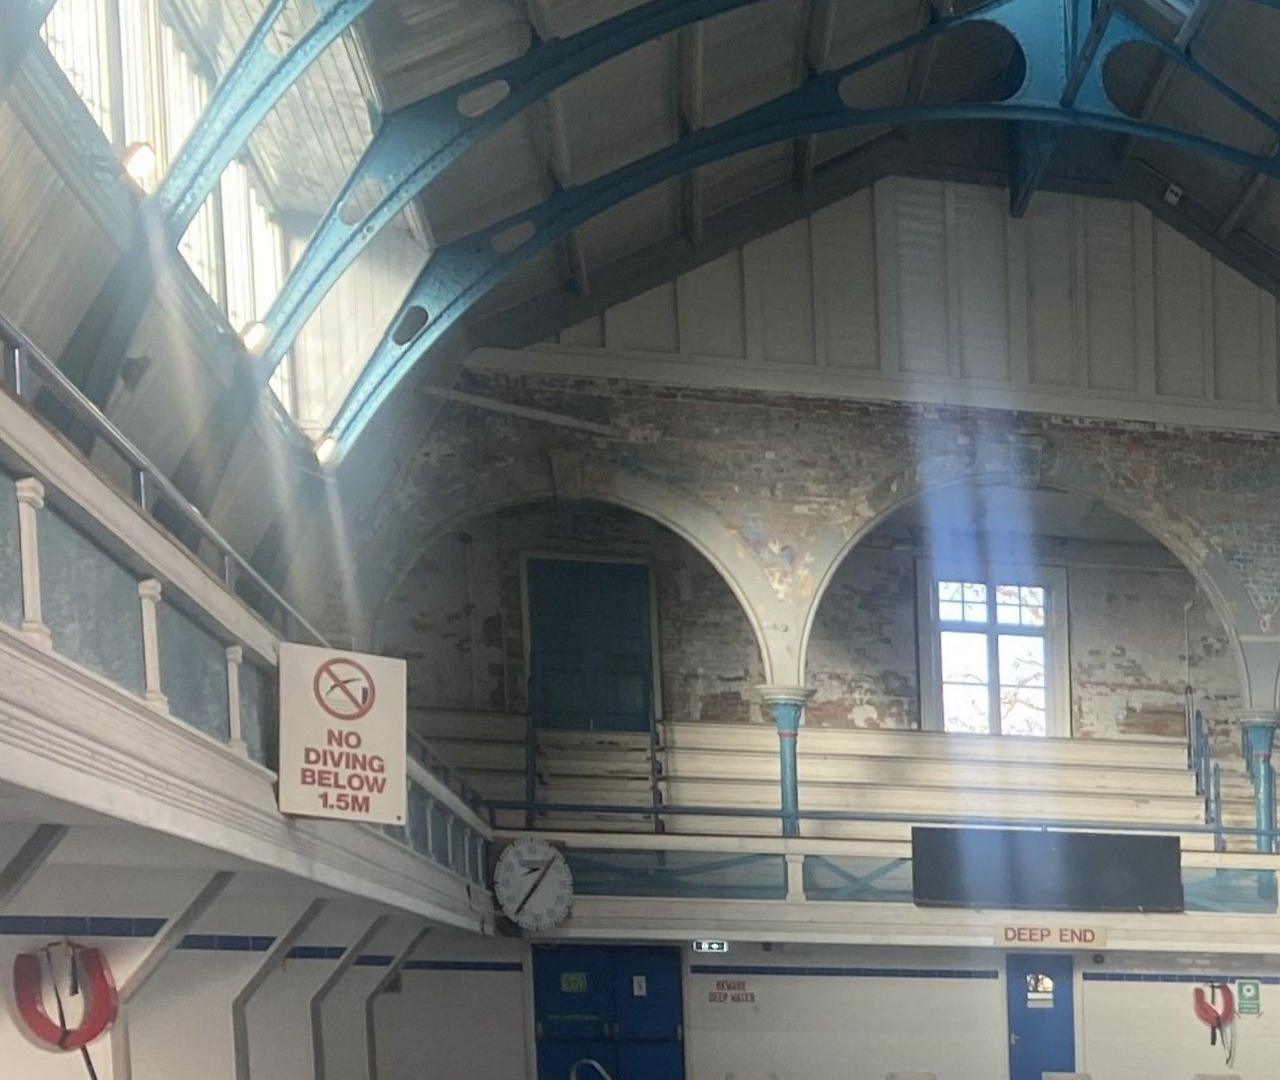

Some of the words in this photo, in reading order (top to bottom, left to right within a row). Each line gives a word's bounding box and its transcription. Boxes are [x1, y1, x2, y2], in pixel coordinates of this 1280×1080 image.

[327, 729, 362, 749] NO
[304, 747, 385, 773] DIVING
[300, 768, 387, 794] BELOW
[318, 792, 370, 813] 1.5M
[1004, 927, 1051, 942] DEEP
[1059, 928, 1096, 943] END
[716, 980, 746, 991] BEWARE
[708, 991, 729, 1003] DEEP
[731, 992, 756, 1003] WATER
